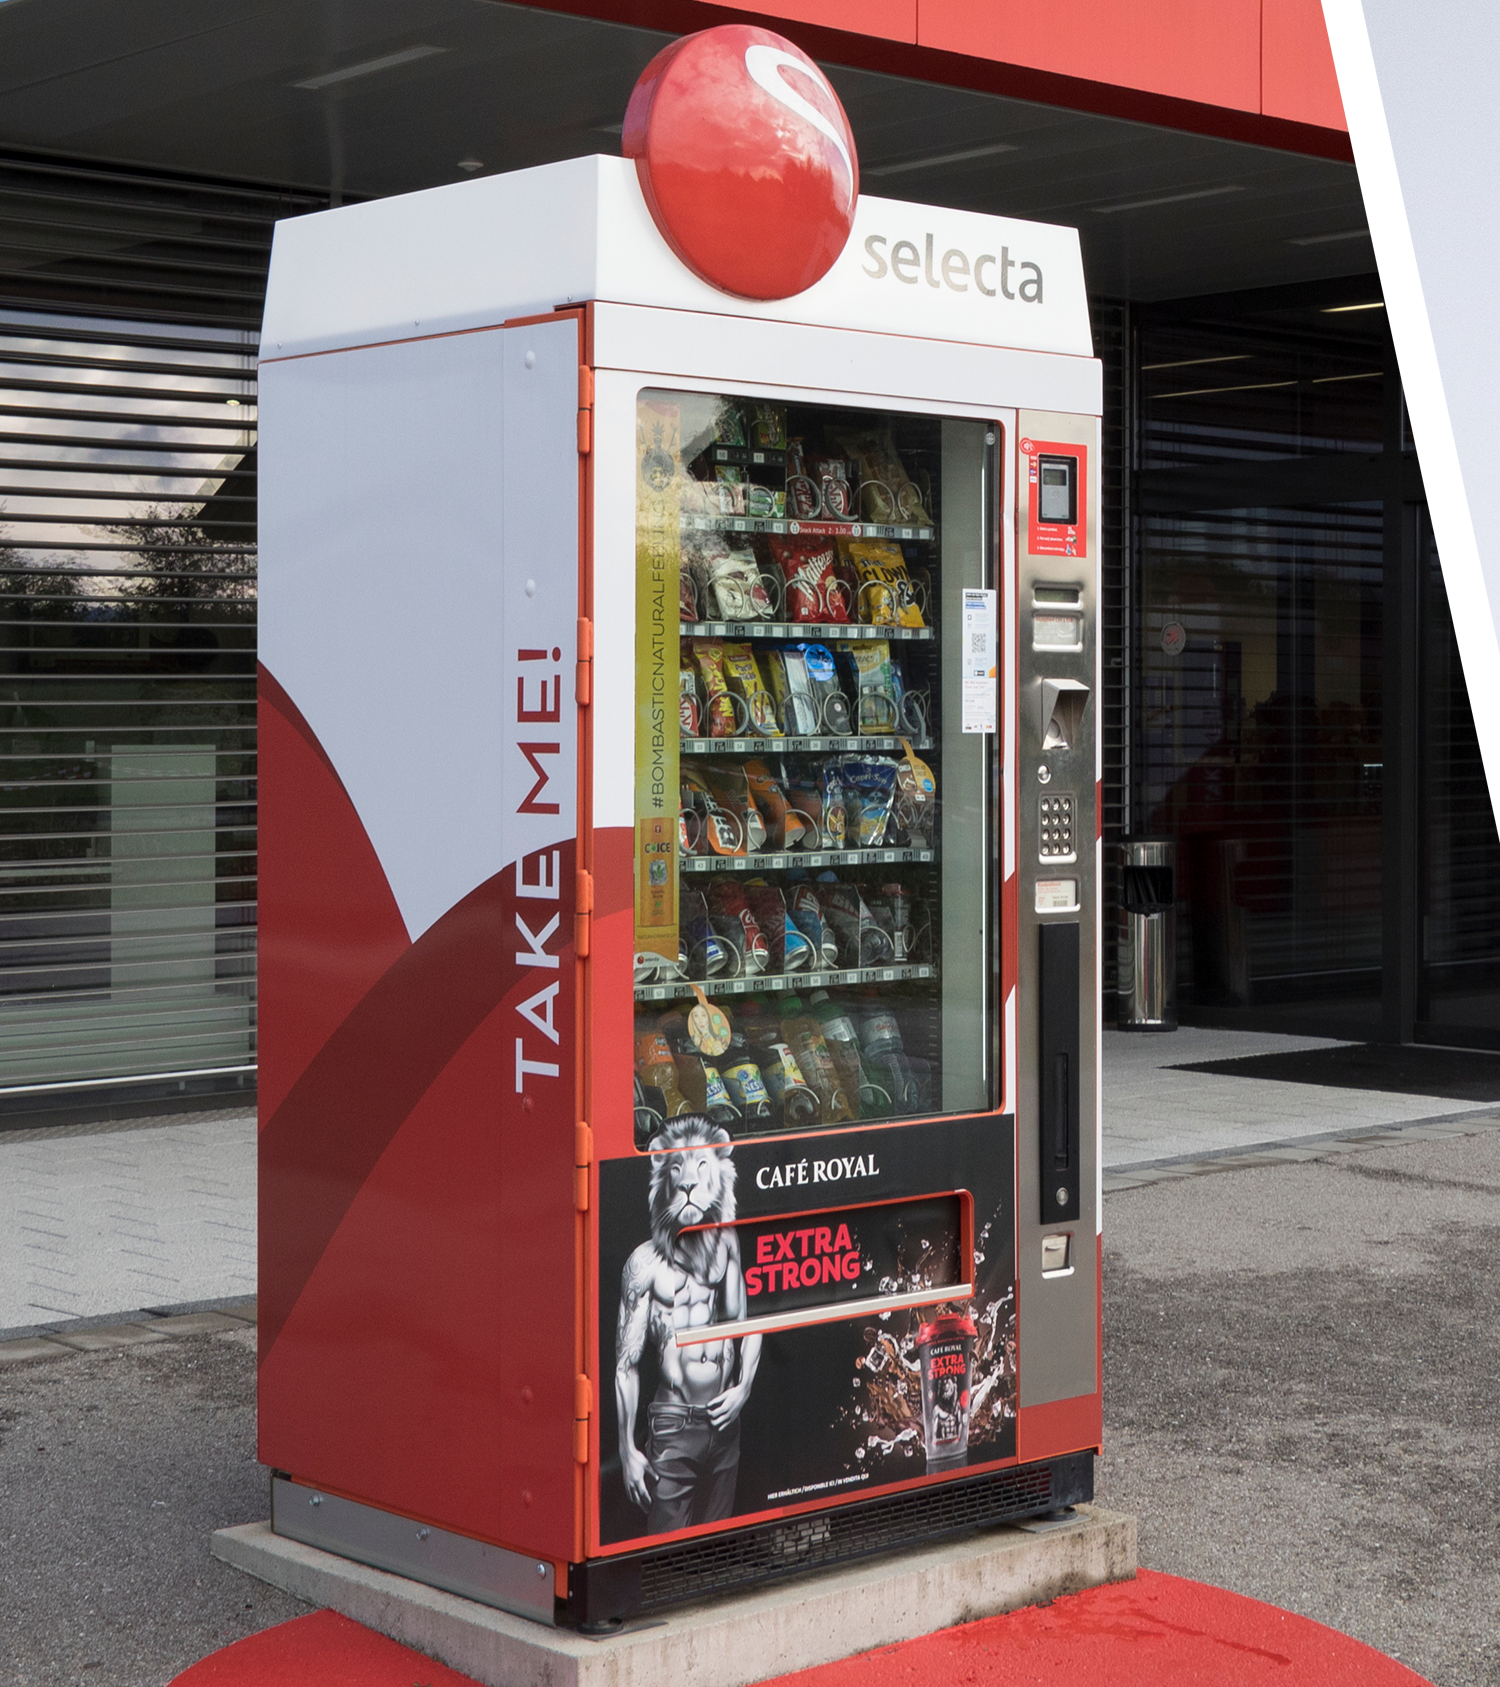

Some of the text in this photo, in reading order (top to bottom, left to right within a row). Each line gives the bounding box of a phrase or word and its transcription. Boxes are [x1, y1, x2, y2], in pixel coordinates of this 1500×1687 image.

[861, 232, 1044, 305] selecta
[515, 646, 561, 1094] TAKE ME!
[756, 1154, 880, 1190] CAFÉ ROYAL
[756, 1223, 852, 1265] EXTRA
[745, 1251, 861, 1296] STRONG
[927, 1363, 966, 1380] STRONG
[930, 1353, 964, 1369] EXTRA
